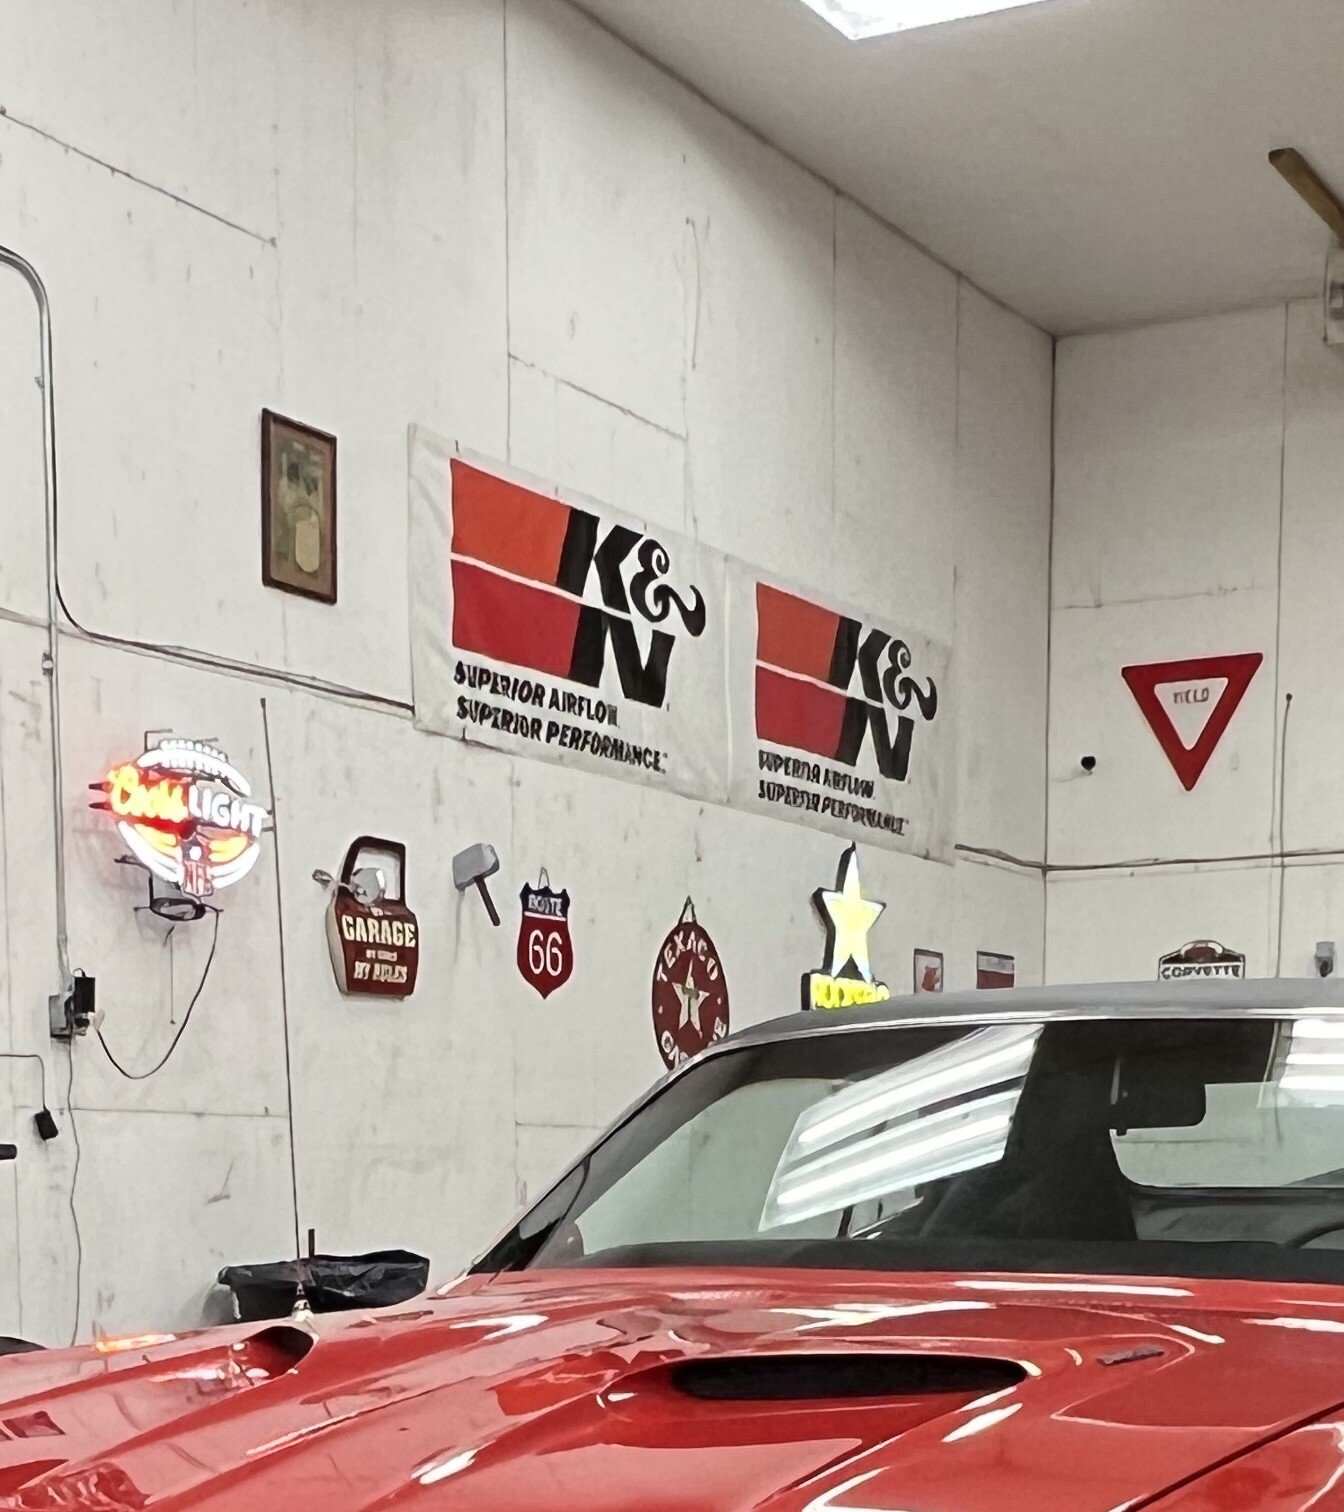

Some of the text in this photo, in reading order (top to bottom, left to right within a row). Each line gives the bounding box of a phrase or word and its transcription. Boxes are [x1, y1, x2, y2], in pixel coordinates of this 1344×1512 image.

[453, 660, 547, 708] SUPERIOR
[456, 695, 543, 742] SUPERIOR
[188, 784, 270, 837] LIGHT
[341, 914, 416, 948] GARAGE
[528, 929, 563, 977] 66
[656, 930, 720, 982] TEXACO
